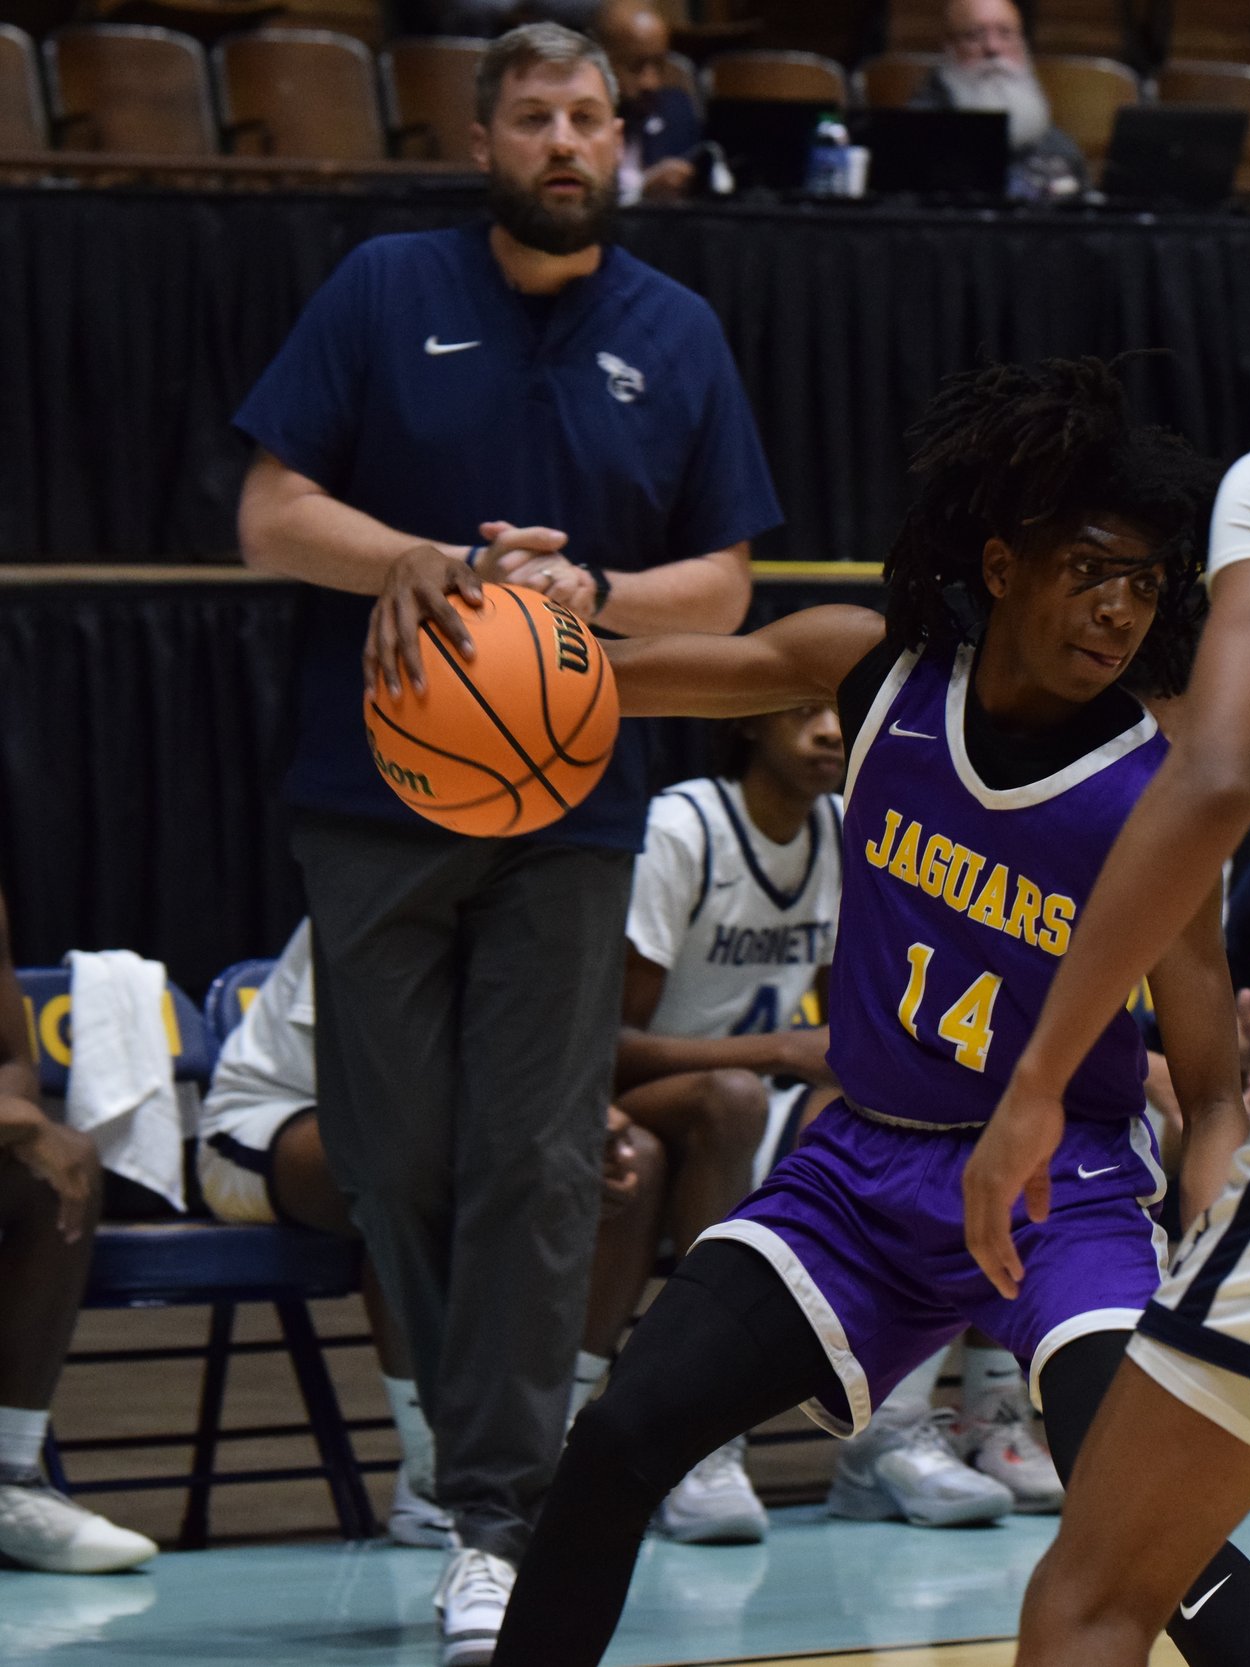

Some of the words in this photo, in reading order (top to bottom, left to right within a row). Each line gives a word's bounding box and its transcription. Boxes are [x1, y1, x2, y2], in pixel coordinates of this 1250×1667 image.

[542, 600, 589, 675] Wil
[865, 808, 1077, 957] JAGUARS
[898, 942, 1004, 1074] 14
